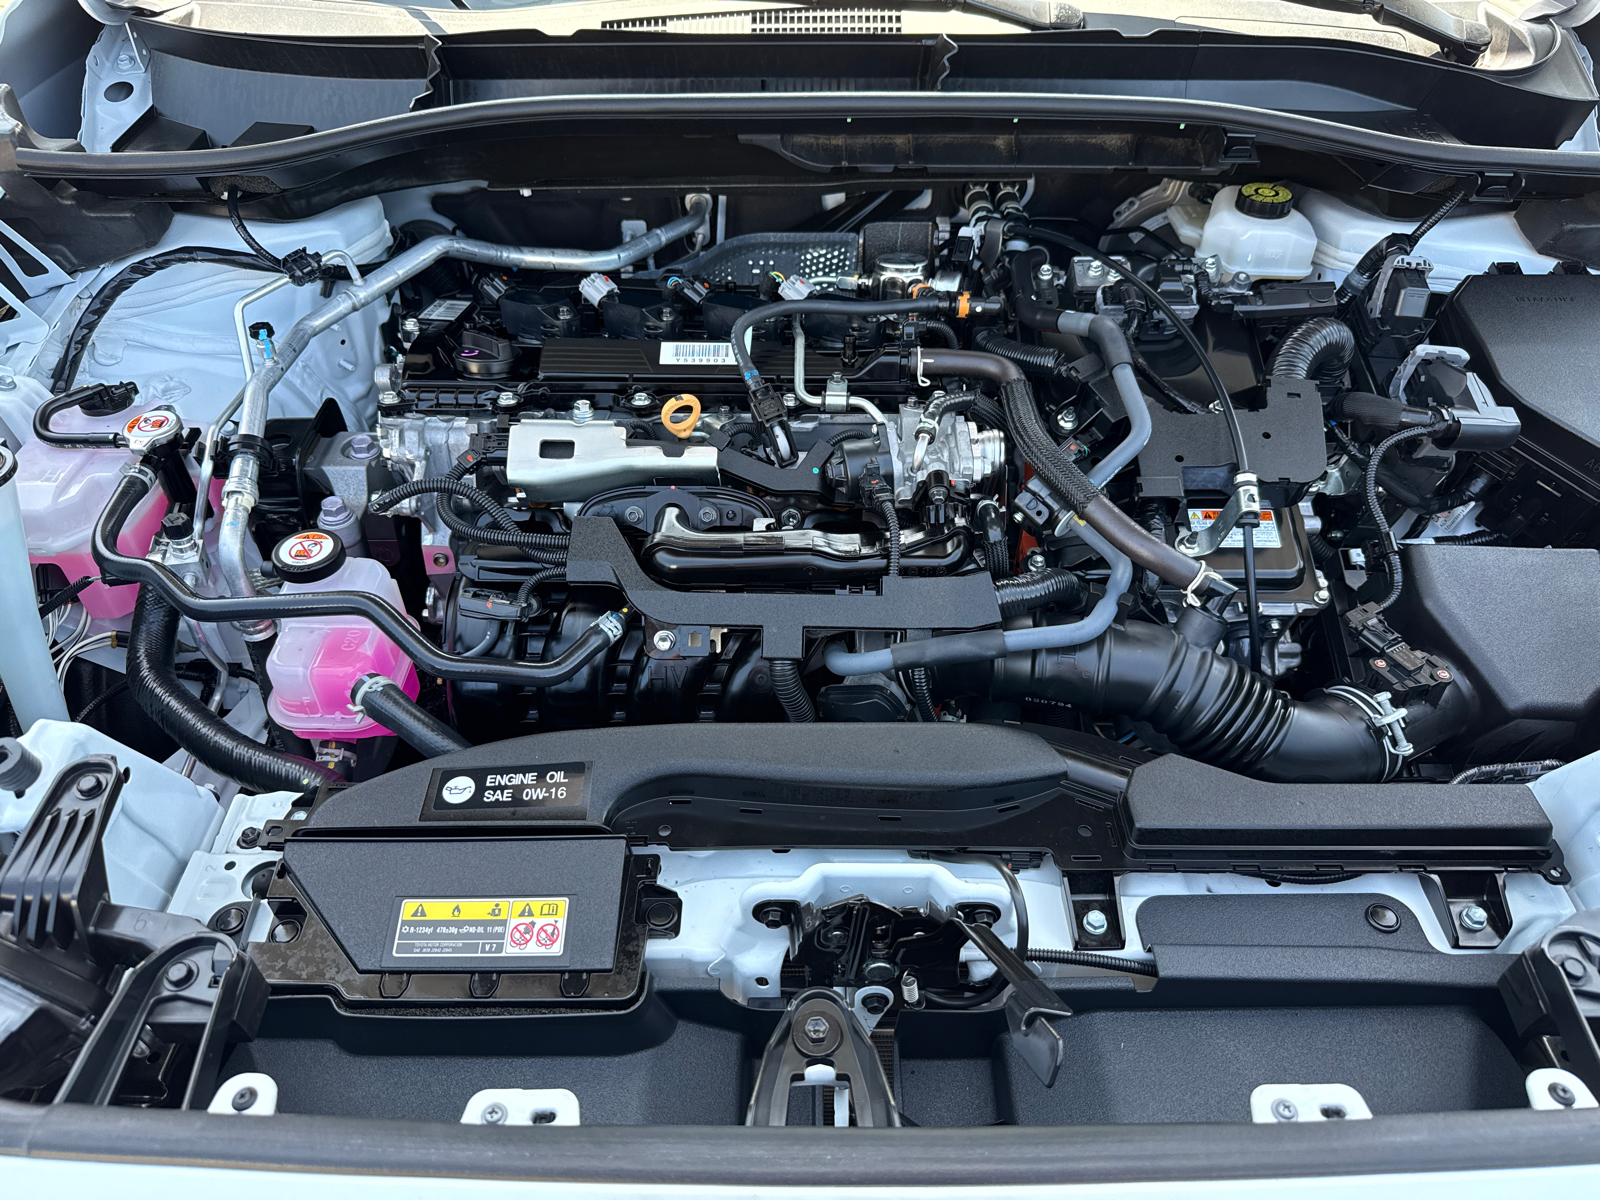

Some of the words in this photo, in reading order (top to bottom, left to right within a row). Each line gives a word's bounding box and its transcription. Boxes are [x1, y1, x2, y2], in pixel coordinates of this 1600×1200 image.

[648, 665, 689, 690] HV
[486, 772, 538, 787] ENGINE
[546, 770, 569, 783] OIL
[483, 789, 513, 802] SAE
[522, 786, 567, 801] 0W-16
[409, 926, 434, 935] R-1234yf
[485, 943, 491, 952] V
[491, 943, 497, 952] 7
